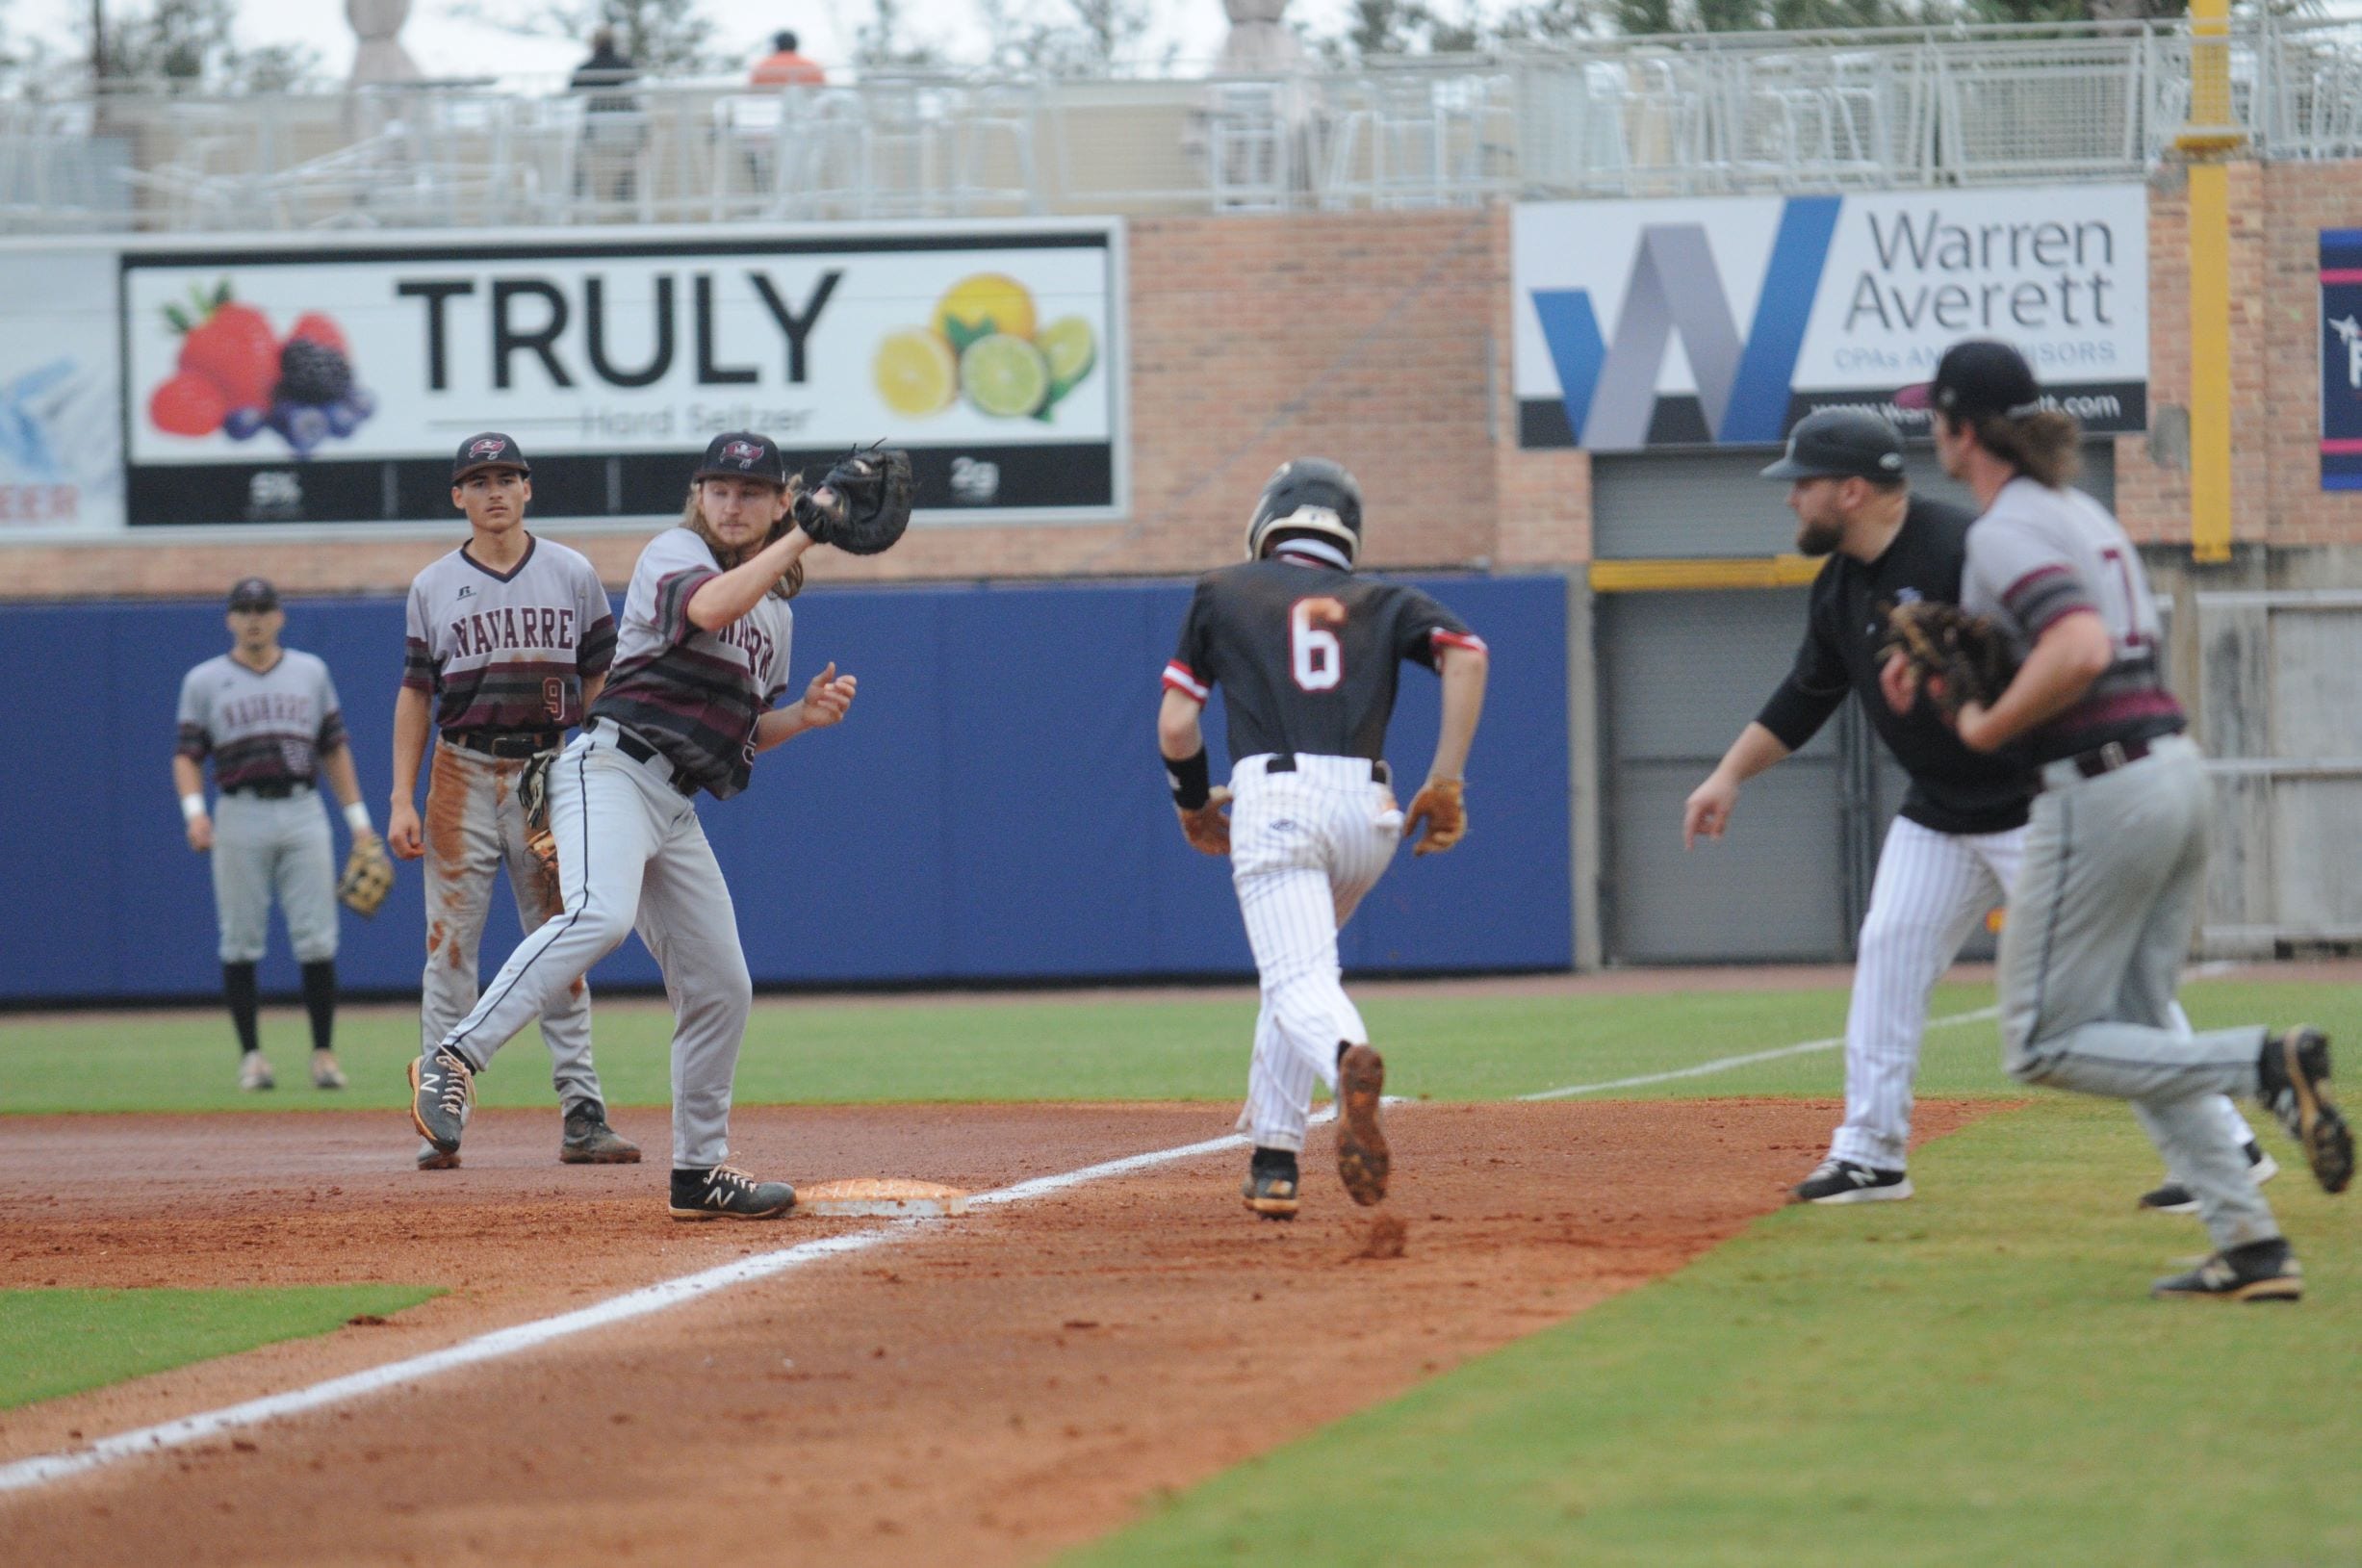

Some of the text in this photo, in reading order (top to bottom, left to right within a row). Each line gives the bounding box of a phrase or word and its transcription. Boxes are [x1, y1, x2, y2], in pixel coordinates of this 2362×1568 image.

[1865, 209, 2113, 272] Warren
[1844, 271, 2113, 332] Averett
[397, 270, 845, 391] TRULY
[1834, 347, 1900, 371] CPAs
[1906, 344, 1940, 367] AN
[580, 401, 813, 435] Hard Seltzer
[449, 606, 575, 659] NAVARRE
[1288, 596, 1347, 693] 6
[543, 677, 566, 721] 9
